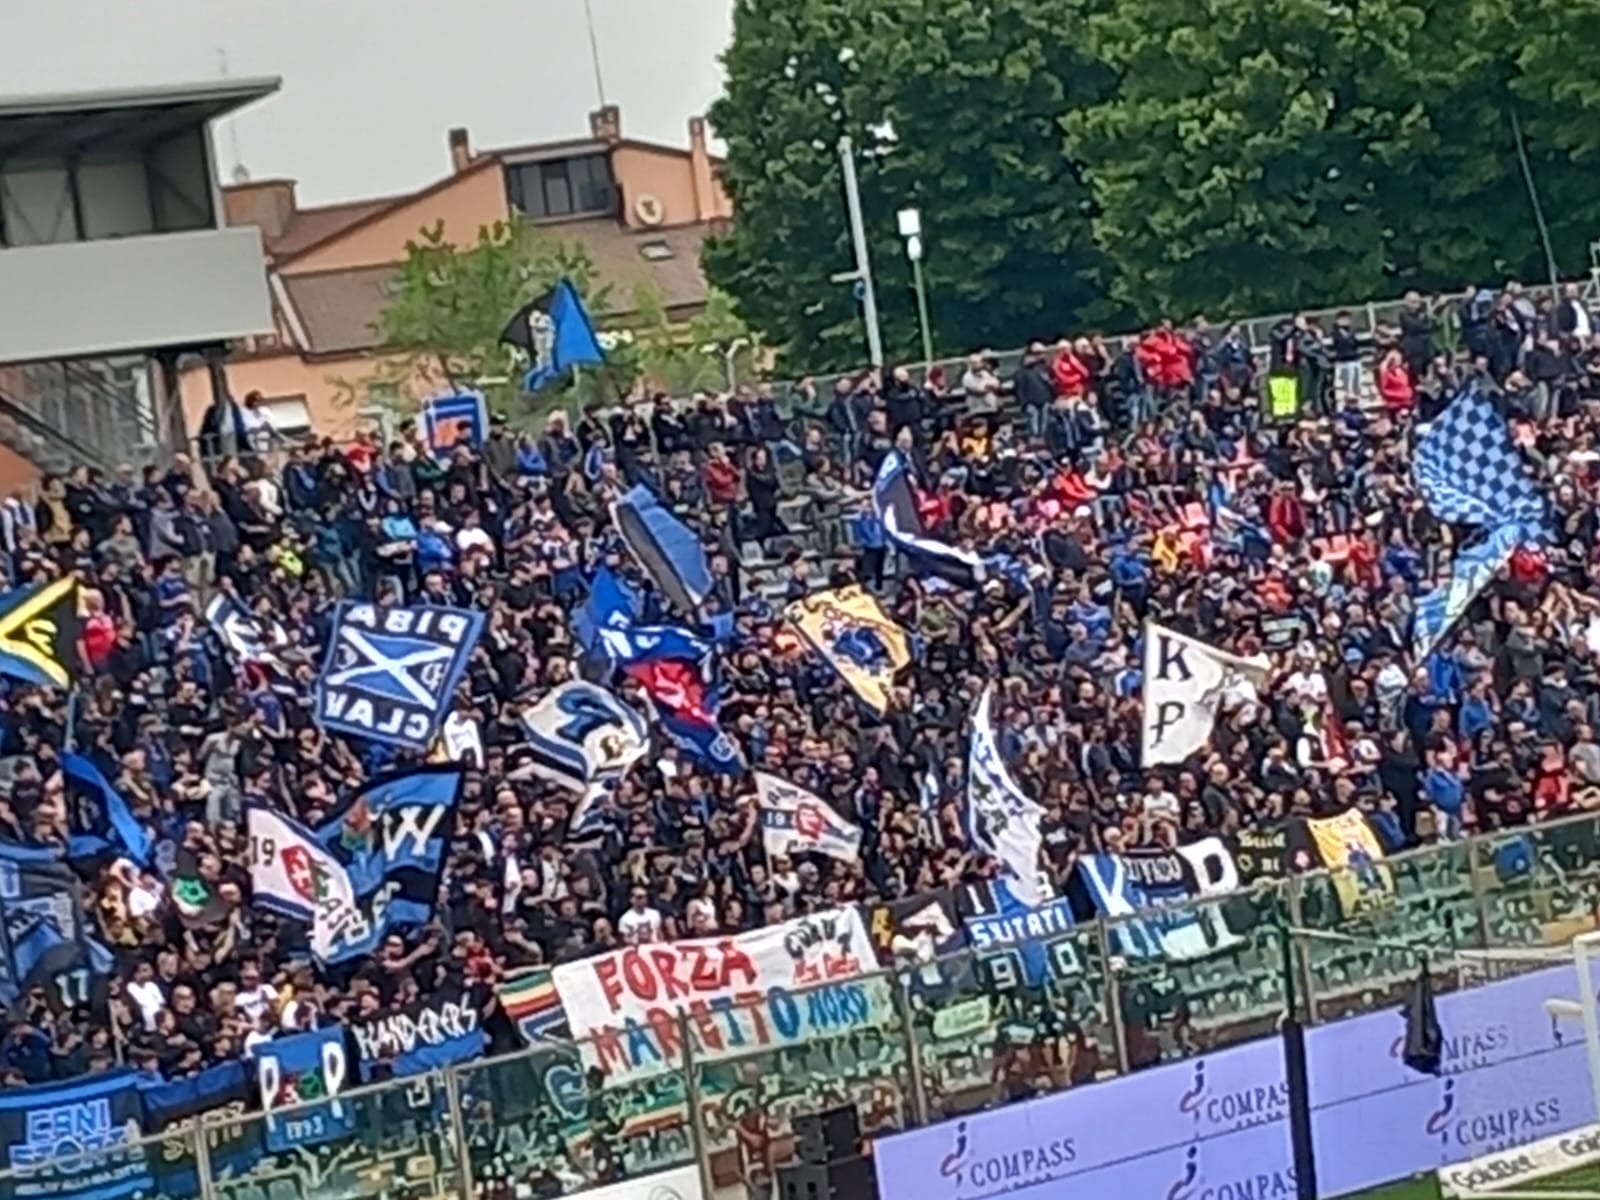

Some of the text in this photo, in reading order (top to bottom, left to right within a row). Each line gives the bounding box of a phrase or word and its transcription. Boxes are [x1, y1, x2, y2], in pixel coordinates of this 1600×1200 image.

[593, 936, 758, 1011] FORZA
[1206, 1081, 1290, 1123] COMPAS
[1456, 1098, 1562, 1146] COMPASS
[970, 1138, 1077, 1187] COMPASS
